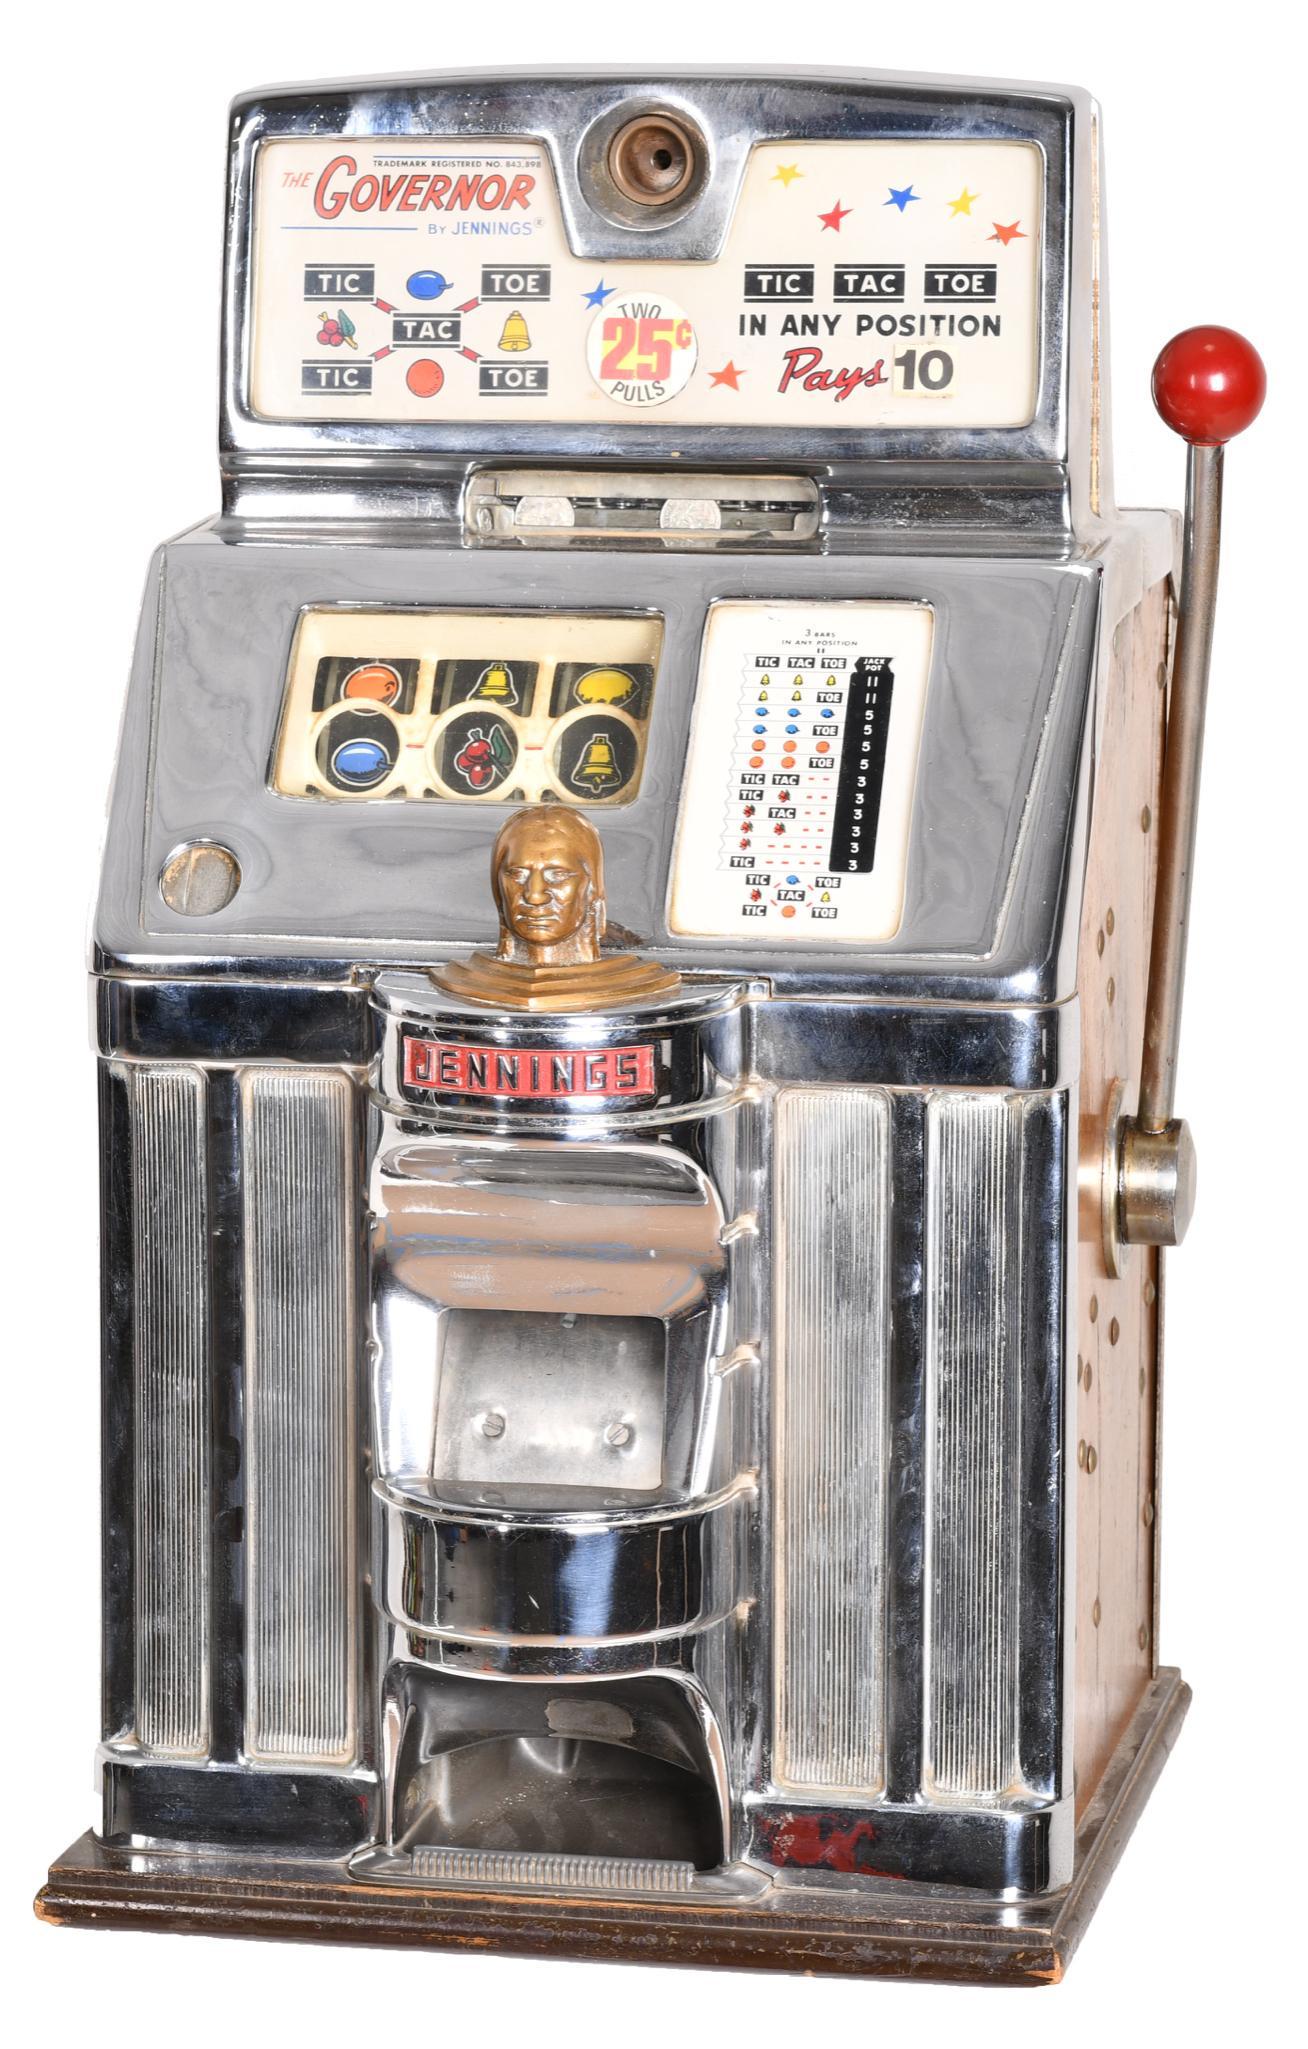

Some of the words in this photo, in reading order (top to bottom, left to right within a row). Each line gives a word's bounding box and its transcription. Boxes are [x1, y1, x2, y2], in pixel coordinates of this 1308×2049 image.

[373, 160, 428, 168] TRADEMARK
[431, 160, 482, 168] REGISTERED
[281, 172, 314, 188] THE
[314, 155, 536, 219] GOVERNOR
[318, 274, 361, 293] TIC
[490, 274, 541, 293] TOE
[756, 274, 802, 294] TIC
[843, 274, 897, 294] TAC
[933, 274, 984, 294] TOE
[617, 303, 662, 319] TWO
[402, 322, 453, 339] TAC
[739, 314, 767, 337] IN
[780, 314, 842, 337] ANY
[856, 314, 1001, 337] POSITION
[316, 368, 359, 387] TIC
[488, 369, 538, 387] TOE
[777, 346, 888, 402] Pays
[894, 350, 954, 390] 10
[610, 380, 665, 402] PULLS
[805, 629, 811, 637] 3
[758, 658, 777, 667] TIC
[790, 659, 812, 667] TAC
[823, 659, 845, 668] TOE
[819, 693, 841, 702] TOE
[865, 710, 874, 720] 5
[815, 726, 837, 735] TOE
[863, 725, 872, 735] 5
[861, 742, 870, 752] 5
[811, 759, 832, 767] TOE
[859, 759, 869, 769] 5
[743, 775, 763, 783] TIC
[774, 776, 797, 784] TAC
[857, 776, 866, 787] 3
[742, 791, 761, 799] TIC
[855, 793, 864, 804] 3
[771, 809, 794, 817] TAC
[853, 809, 862, 820] 3
[851, 826, 860, 837] 3
[850, 842, 859, 853] 3
[732, 858, 753, 866] TIC
[848, 860, 857, 870] 3
[748, 875, 768, 884] TIC
[817, 878, 839, 887] TOE
[780, 891, 803, 900] TAC
[745, 906, 765, 915] TIC
[813, 909, 835, 917] TOE
[415, 1048, 639, 1091] JENNINGS
